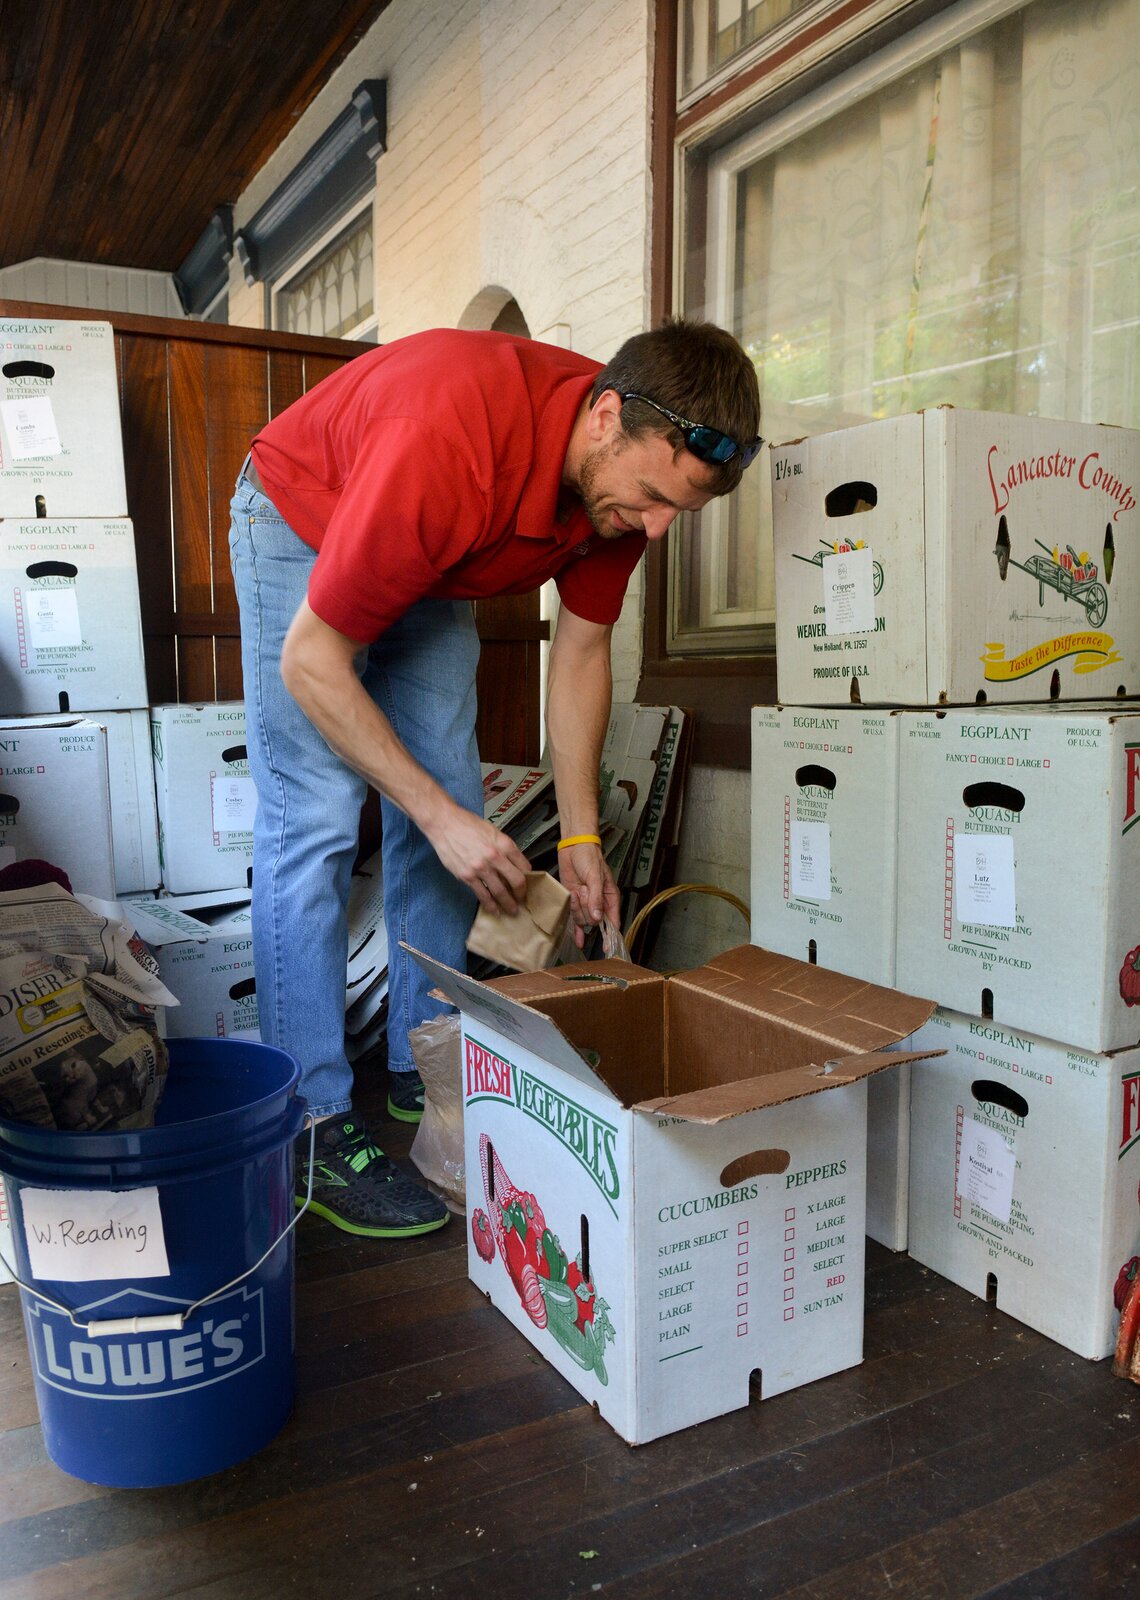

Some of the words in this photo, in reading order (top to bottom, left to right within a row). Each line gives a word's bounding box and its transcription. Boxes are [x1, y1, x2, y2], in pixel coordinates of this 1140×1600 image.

[0, 324, 54, 334] GGPLANT
[9, 377, 53, 387] SQUASH
[987, 445, 1076, 516] Lancaster
[1077, 452, 1136, 522] County
[20, 525, 78, 535] EGGPLANT
[33, 577, 77, 587] SQUASH
[832, 582, 855, 593] Crippen
[797, 623, 827, 639] WEAVER
[813, 643, 823, 653] New
[1008, 657, 1033, 673] Taste
[1035, 646, 1050, 663] the
[1053, 634, 1103, 653] Difference
[813, 667, 841, 678] PRODUCE
[842, 666, 850, 677] OF
[852, 665, 870, 676] U.S.A.
[793, 716, 839, 730] EGGPLANT
[862, 719, 885, 727] PRODUCE
[59, 735, 96, 744] PRODUCE
[909, 730, 916, 738] BY
[918, 730, 941, 739] VOLUME
[961, 725, 1031, 741] EGGPLANT
[1066, 727, 1102, 737] PRODUCE
[783, 740, 799, 749] FANCY
[805, 742, 823, 751] CHOICE
[830, 744, 847, 753] LARGE
[1067, 738, 1077, 747] OF
[945, 753, 969, 763] FANCY
[978, 756, 1006, 765] CHOICE
[1016, 758, 1042, 768] LARGE
[6, 766, 35, 775] LARGE
[497, 770, 548, 813] FRESH
[637, 722, 679, 872] PERISHABLE
[799, 785, 834, 800] SQUASH
[797, 799, 828, 810] BUTTERNUT
[797, 807, 827, 819] BUTTERCUP
[968, 806, 1021, 824] SQUASH
[964, 821, 1012, 835] BUTTERNUT
[974, 874, 990, 882] Lutz
[786, 901, 806, 912] GROWN
[807, 907, 820, 917] AND
[820, 911, 843, 923] PACKED
[809, 917, 817, 925] BY
[961, 924, 974, 934] PIE
[974, 927, 1010, 942] PUMPKIN
[947, 943, 978, 957] GROWN
[979, 950, 997, 962] AND
[998, 955, 1032, 970] PACKED
[211, 964, 233, 973] FANCY
[982, 961, 994, 972] BY
[969, 1022, 1035, 1054] EGGPLANT
[19, 1055, 32, 1070] to
[33, 1029, 84, 1059] Rescuing
[956, 1044, 978, 1059] FANCY
[985, 1055, 1012, 1072] CHOICE
[1020, 1067, 1044, 1083] LARGE
[1066, 1052, 1100, 1069] PRODUCE
[1067, 1062, 1079, 1072] OF
[464, 1037, 512, 1098] FRESH
[510, 1062, 620, 1200] VEGETABLES
[658, 1117, 670, 1128] BY
[977, 1101, 1026, 1129] SQUASH
[973, 1112, 1017, 1138] BUTTERNUT
[785, 1159, 848, 1190] PEPPERS
[657, 1183, 759, 1223] CUCUMBERS
[806, 1204, 815, 1215] X
[815, 1195, 846, 1212] LARGE
[815, 1215, 846, 1232] LARGE
[970, 1207, 982, 1219] PIE
[981, 1212, 1014, 1236] PUMPKIN
[657, 1239, 692, 1258] SUPER
[693, 1228, 729, 1248] SELECT
[806, 1234, 846, 1254] MEDIUM
[957, 1221, 985, 1242] GROWN
[985, 1236, 1003, 1251] AND
[1003, 1245, 1034, 1267] PACKED
[988, 1249, 999, 1259] BY
[657, 1260, 693, 1279] SMALL
[812, 1254, 846, 1272] SELECT
[826, 1273, 846, 1288] RED
[657, 1280, 695, 1300] SELECT
[802, 1300, 823, 1315] SUN
[823, 1292, 844, 1309] TAN
[658, 1302, 693, 1322] LARGE
[658, 1323, 691, 1343] PLAIN
[42, 1318, 245, 1387] LOWE'S
